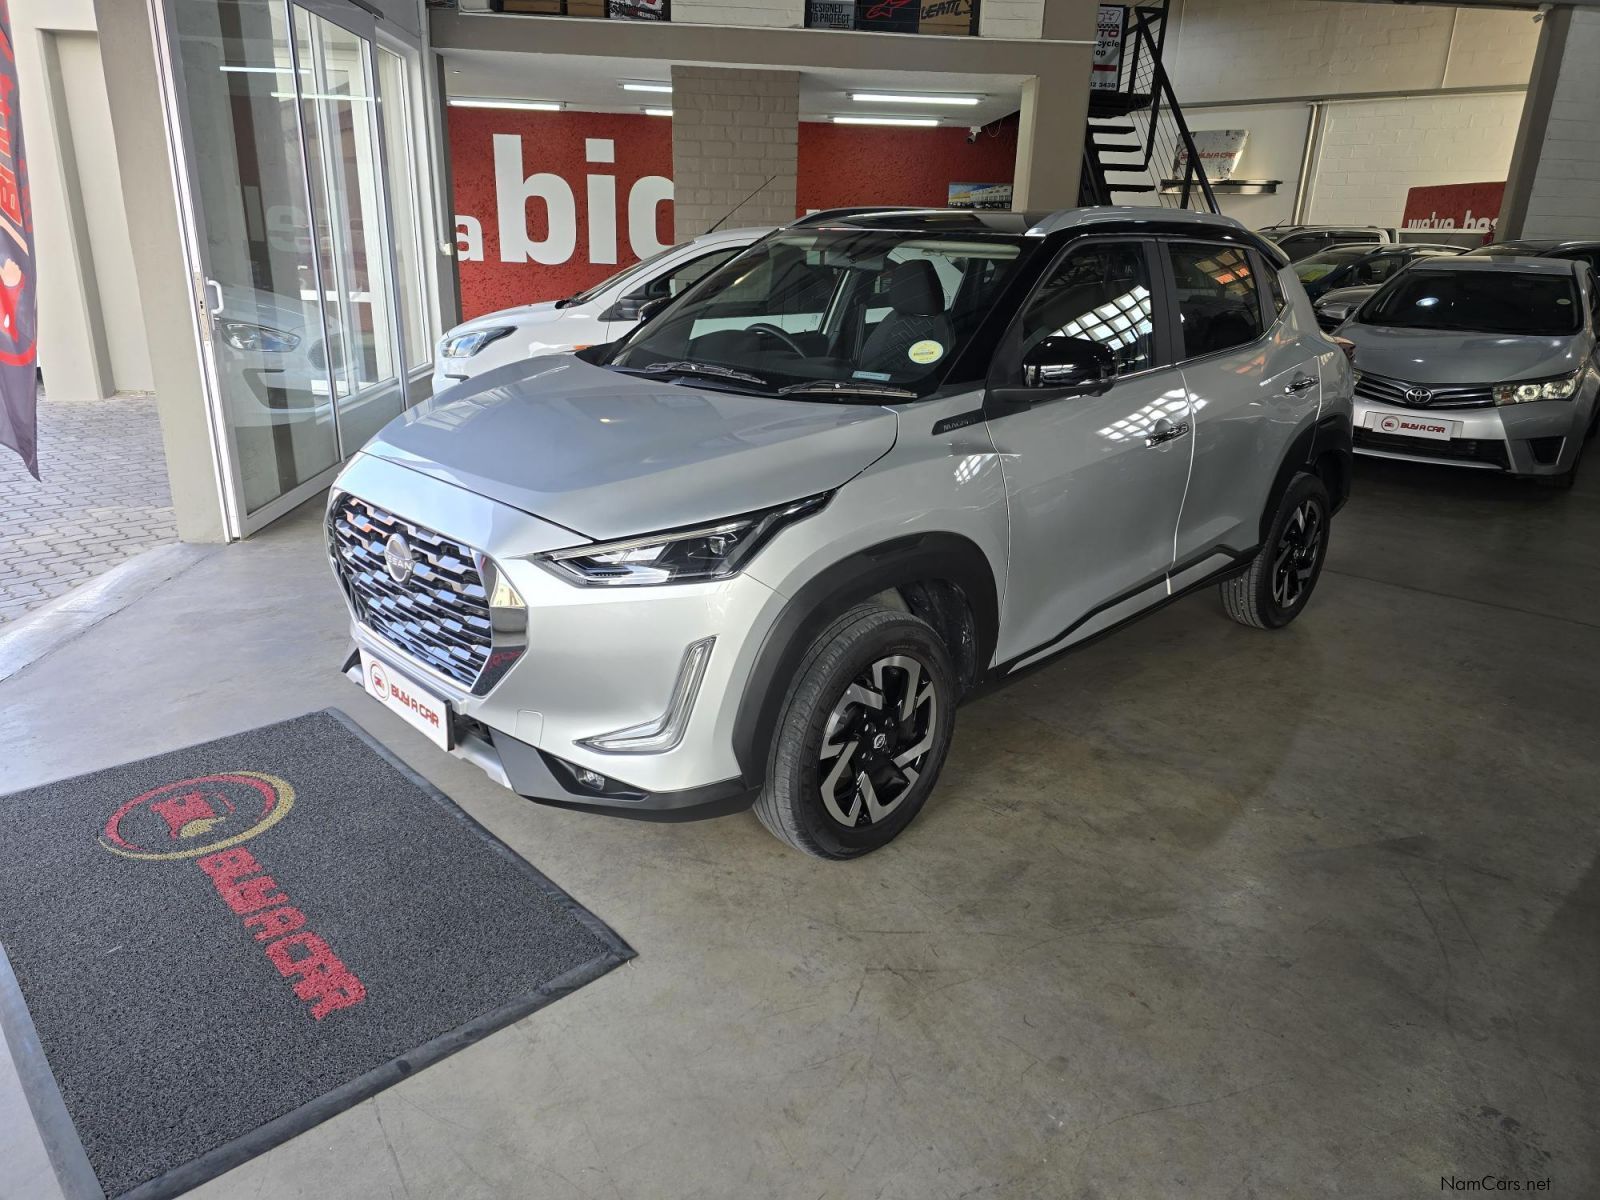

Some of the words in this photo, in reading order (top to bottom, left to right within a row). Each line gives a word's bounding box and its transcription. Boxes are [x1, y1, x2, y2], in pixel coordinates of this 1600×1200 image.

[820, 13, 850, 24] PROTECT
[1400, 422, 1420, 431] BUY
[1426, 425, 1446, 433] CAR
[390, 682, 411, 707] BUY
[411, 698, 419, 713] A
[419, 703, 440, 728] CAR
[196, 846, 290, 916] BUY
[243, 906, 307, 941] A
[265, 931, 367, 1021] CAR
